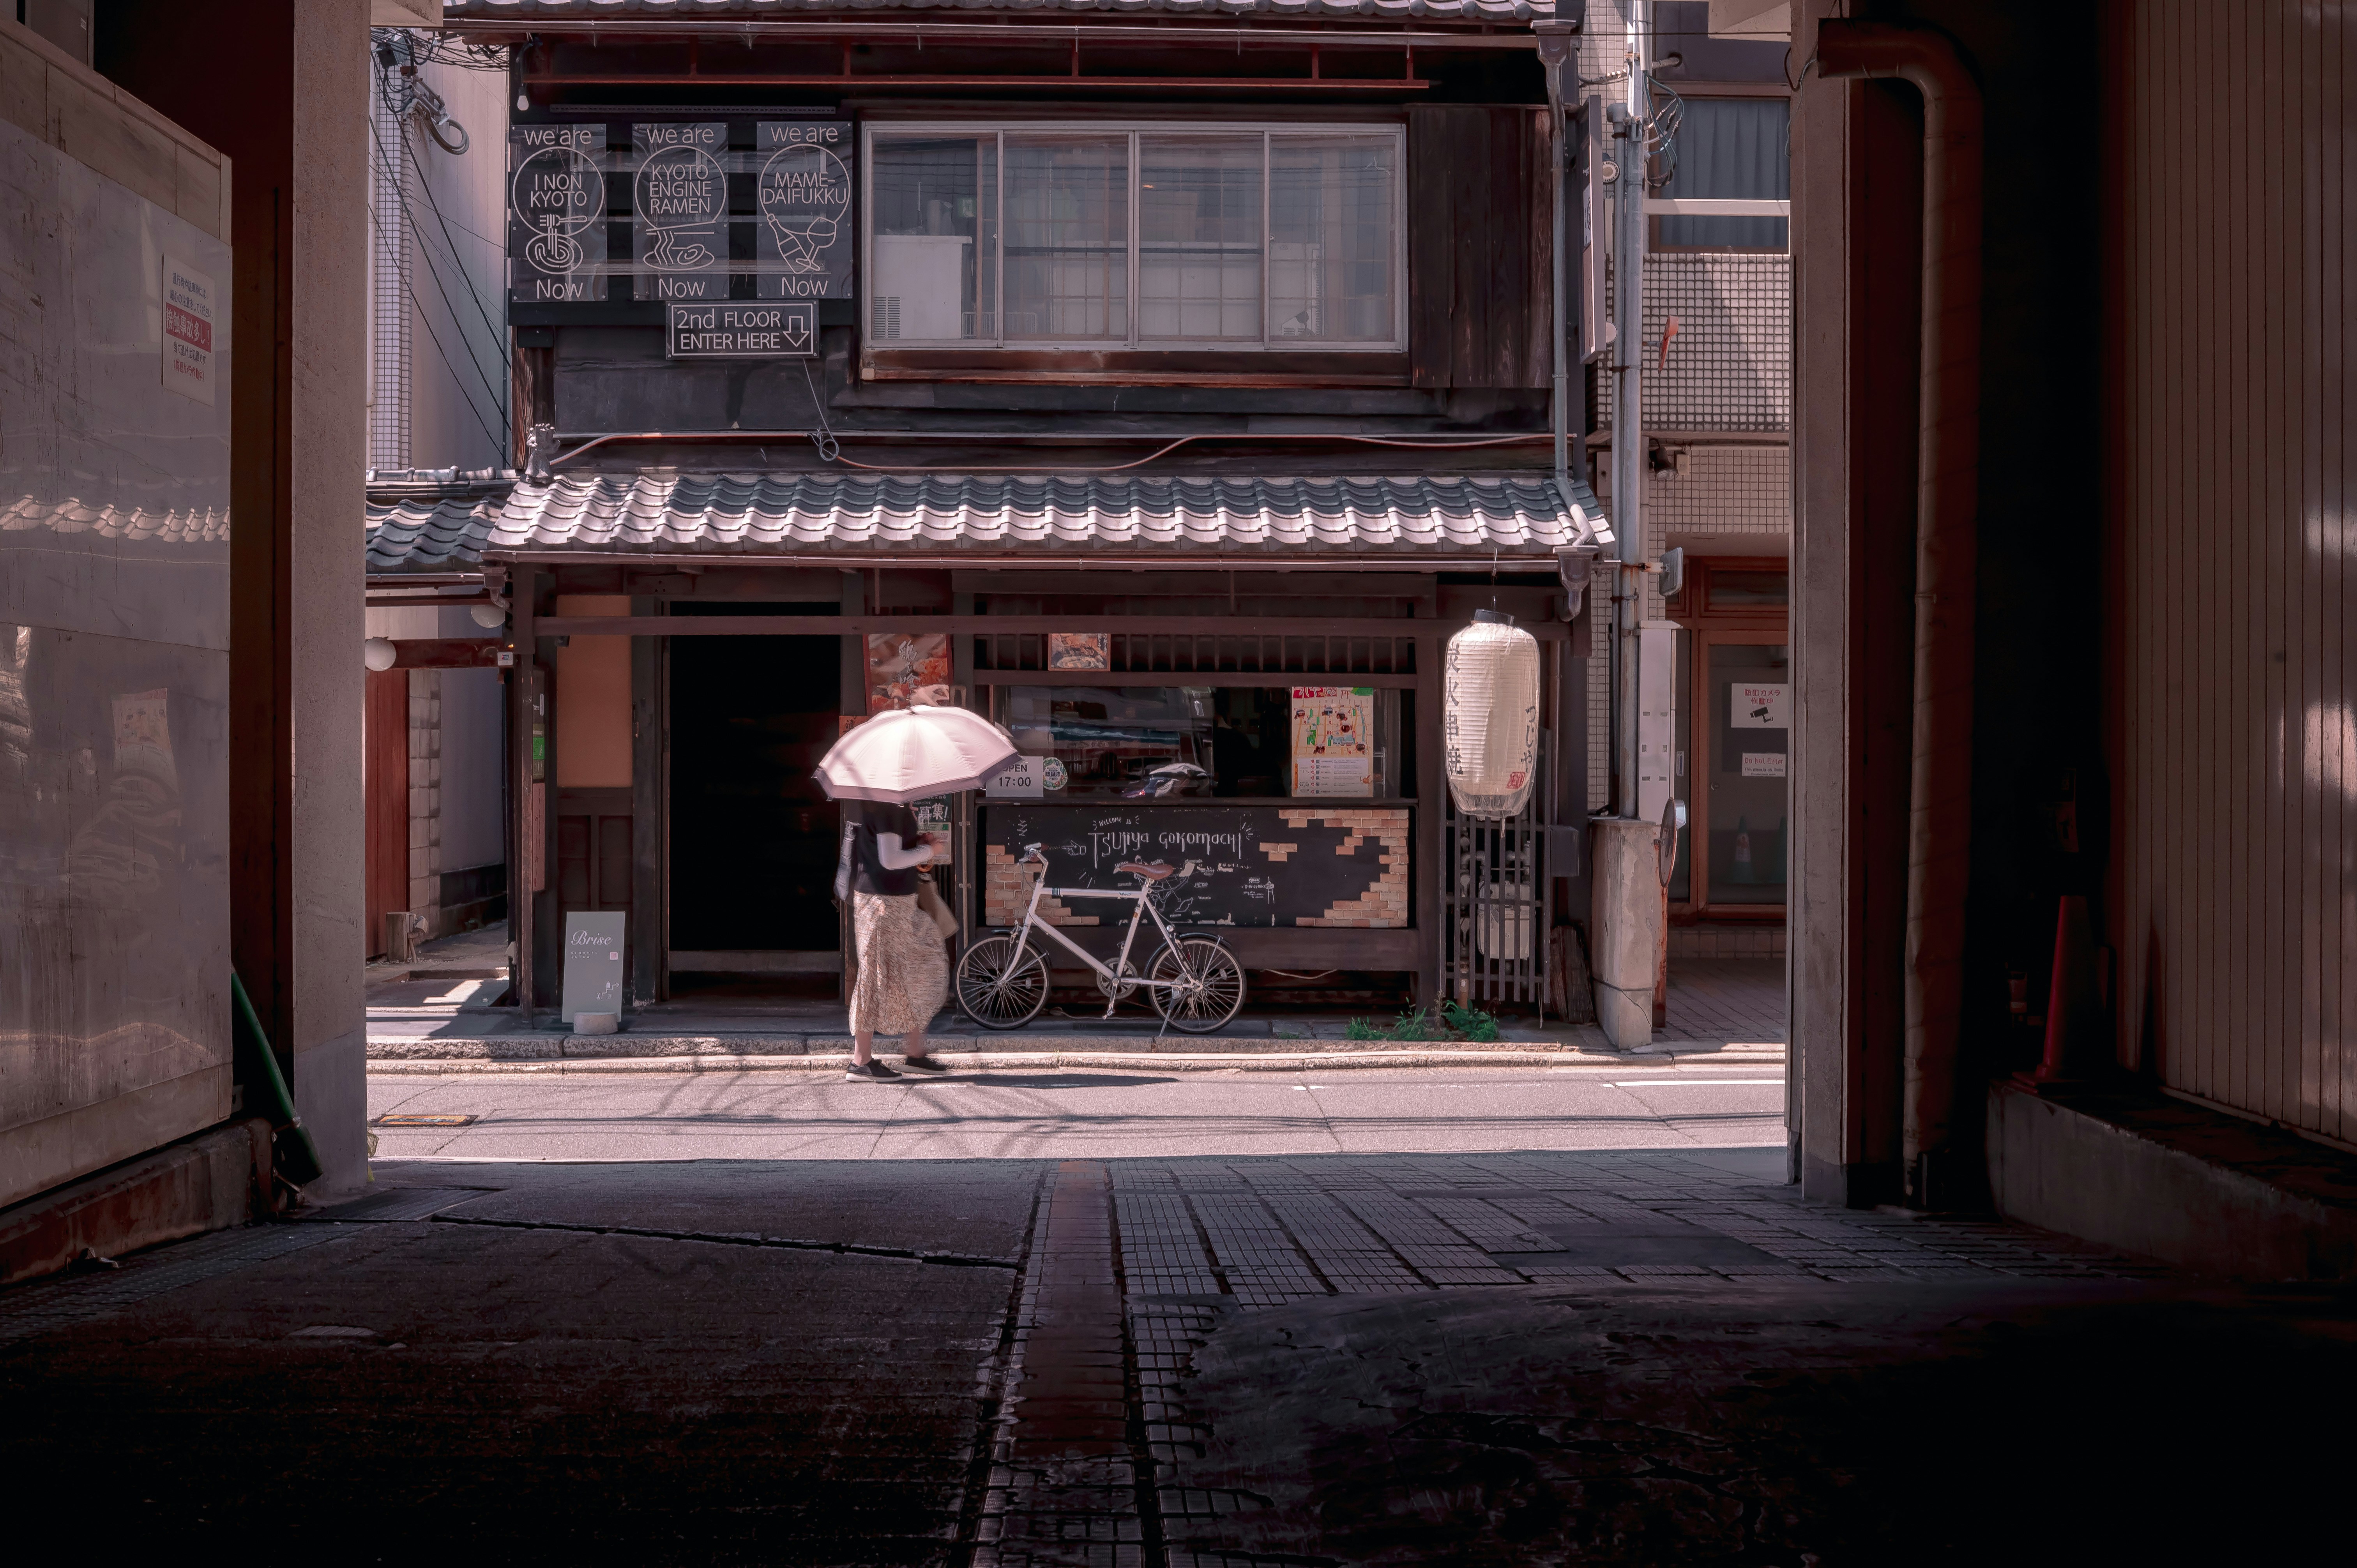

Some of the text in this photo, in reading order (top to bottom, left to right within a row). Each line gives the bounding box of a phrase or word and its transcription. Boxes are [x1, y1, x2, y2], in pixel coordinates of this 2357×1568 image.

[557, 129, 592, 145] are
[682, 128, 714, 143] are
[806, 127, 838, 142] are
[652, 164, 709, 180] KYOTO
[775, 172, 835, 187] MAME-
[544, 174, 582, 190] NON
[650, 182, 712, 197] ENGINE
[530, 191, 587, 207] KYOTO
[650, 198, 710, 214] RAMEN
[537, 280, 583, 299] Now
[659, 278, 705, 298] Now
[782, 277, 828, 296] Now
[677, 309, 780, 329] 2nd FLOOR
[680, 333, 780, 350] ENTER HERE
[998, 777, 1031, 787] 17:00
[571, 930, 613, 945] Brise
